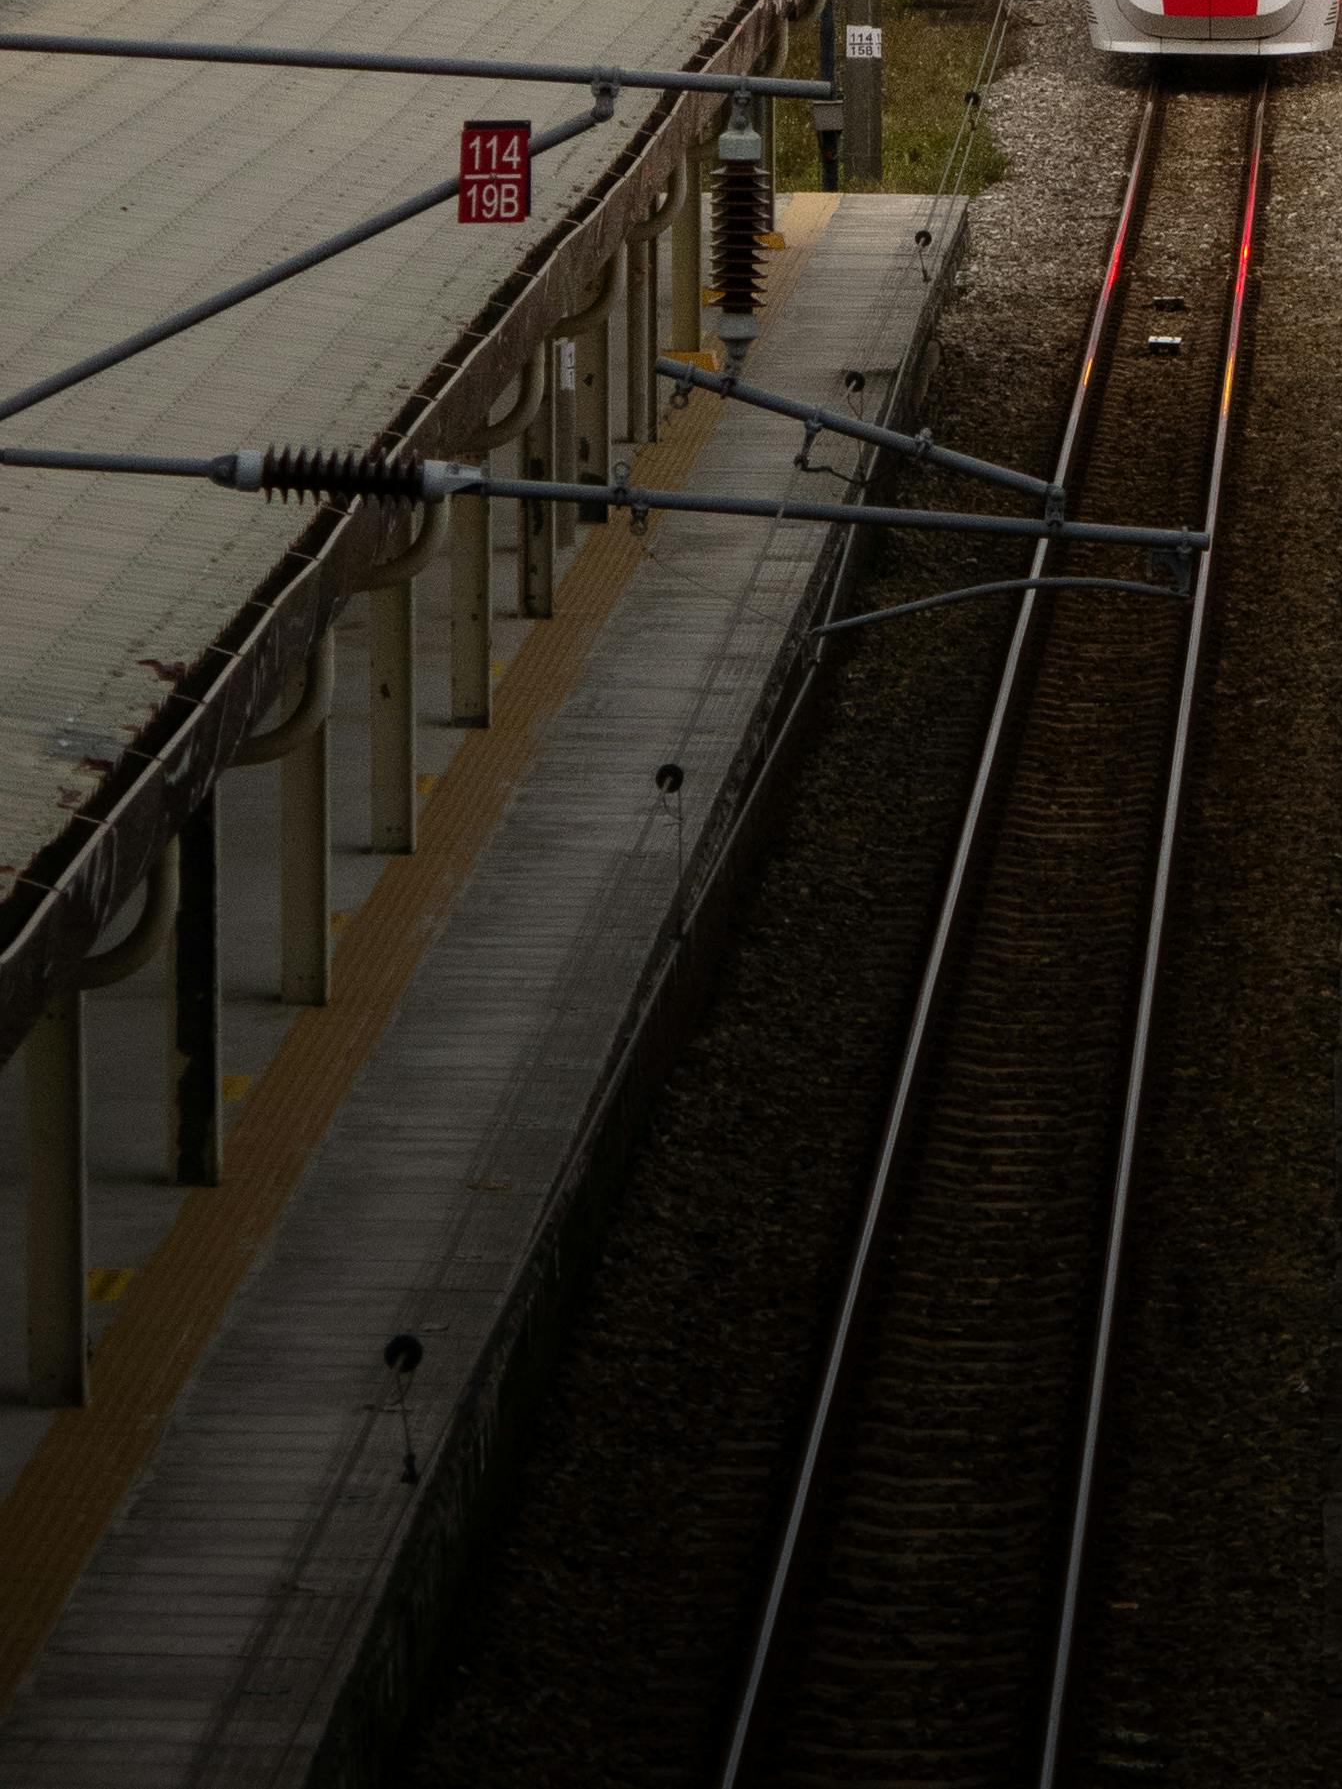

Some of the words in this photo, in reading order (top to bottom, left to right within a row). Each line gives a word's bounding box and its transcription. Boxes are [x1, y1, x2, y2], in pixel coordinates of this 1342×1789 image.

[850, 33, 873, 43] 114
[851, 45, 873, 56] 15B
[468, 135, 521, 170] 114
[466, 183, 519, 219] 19B
